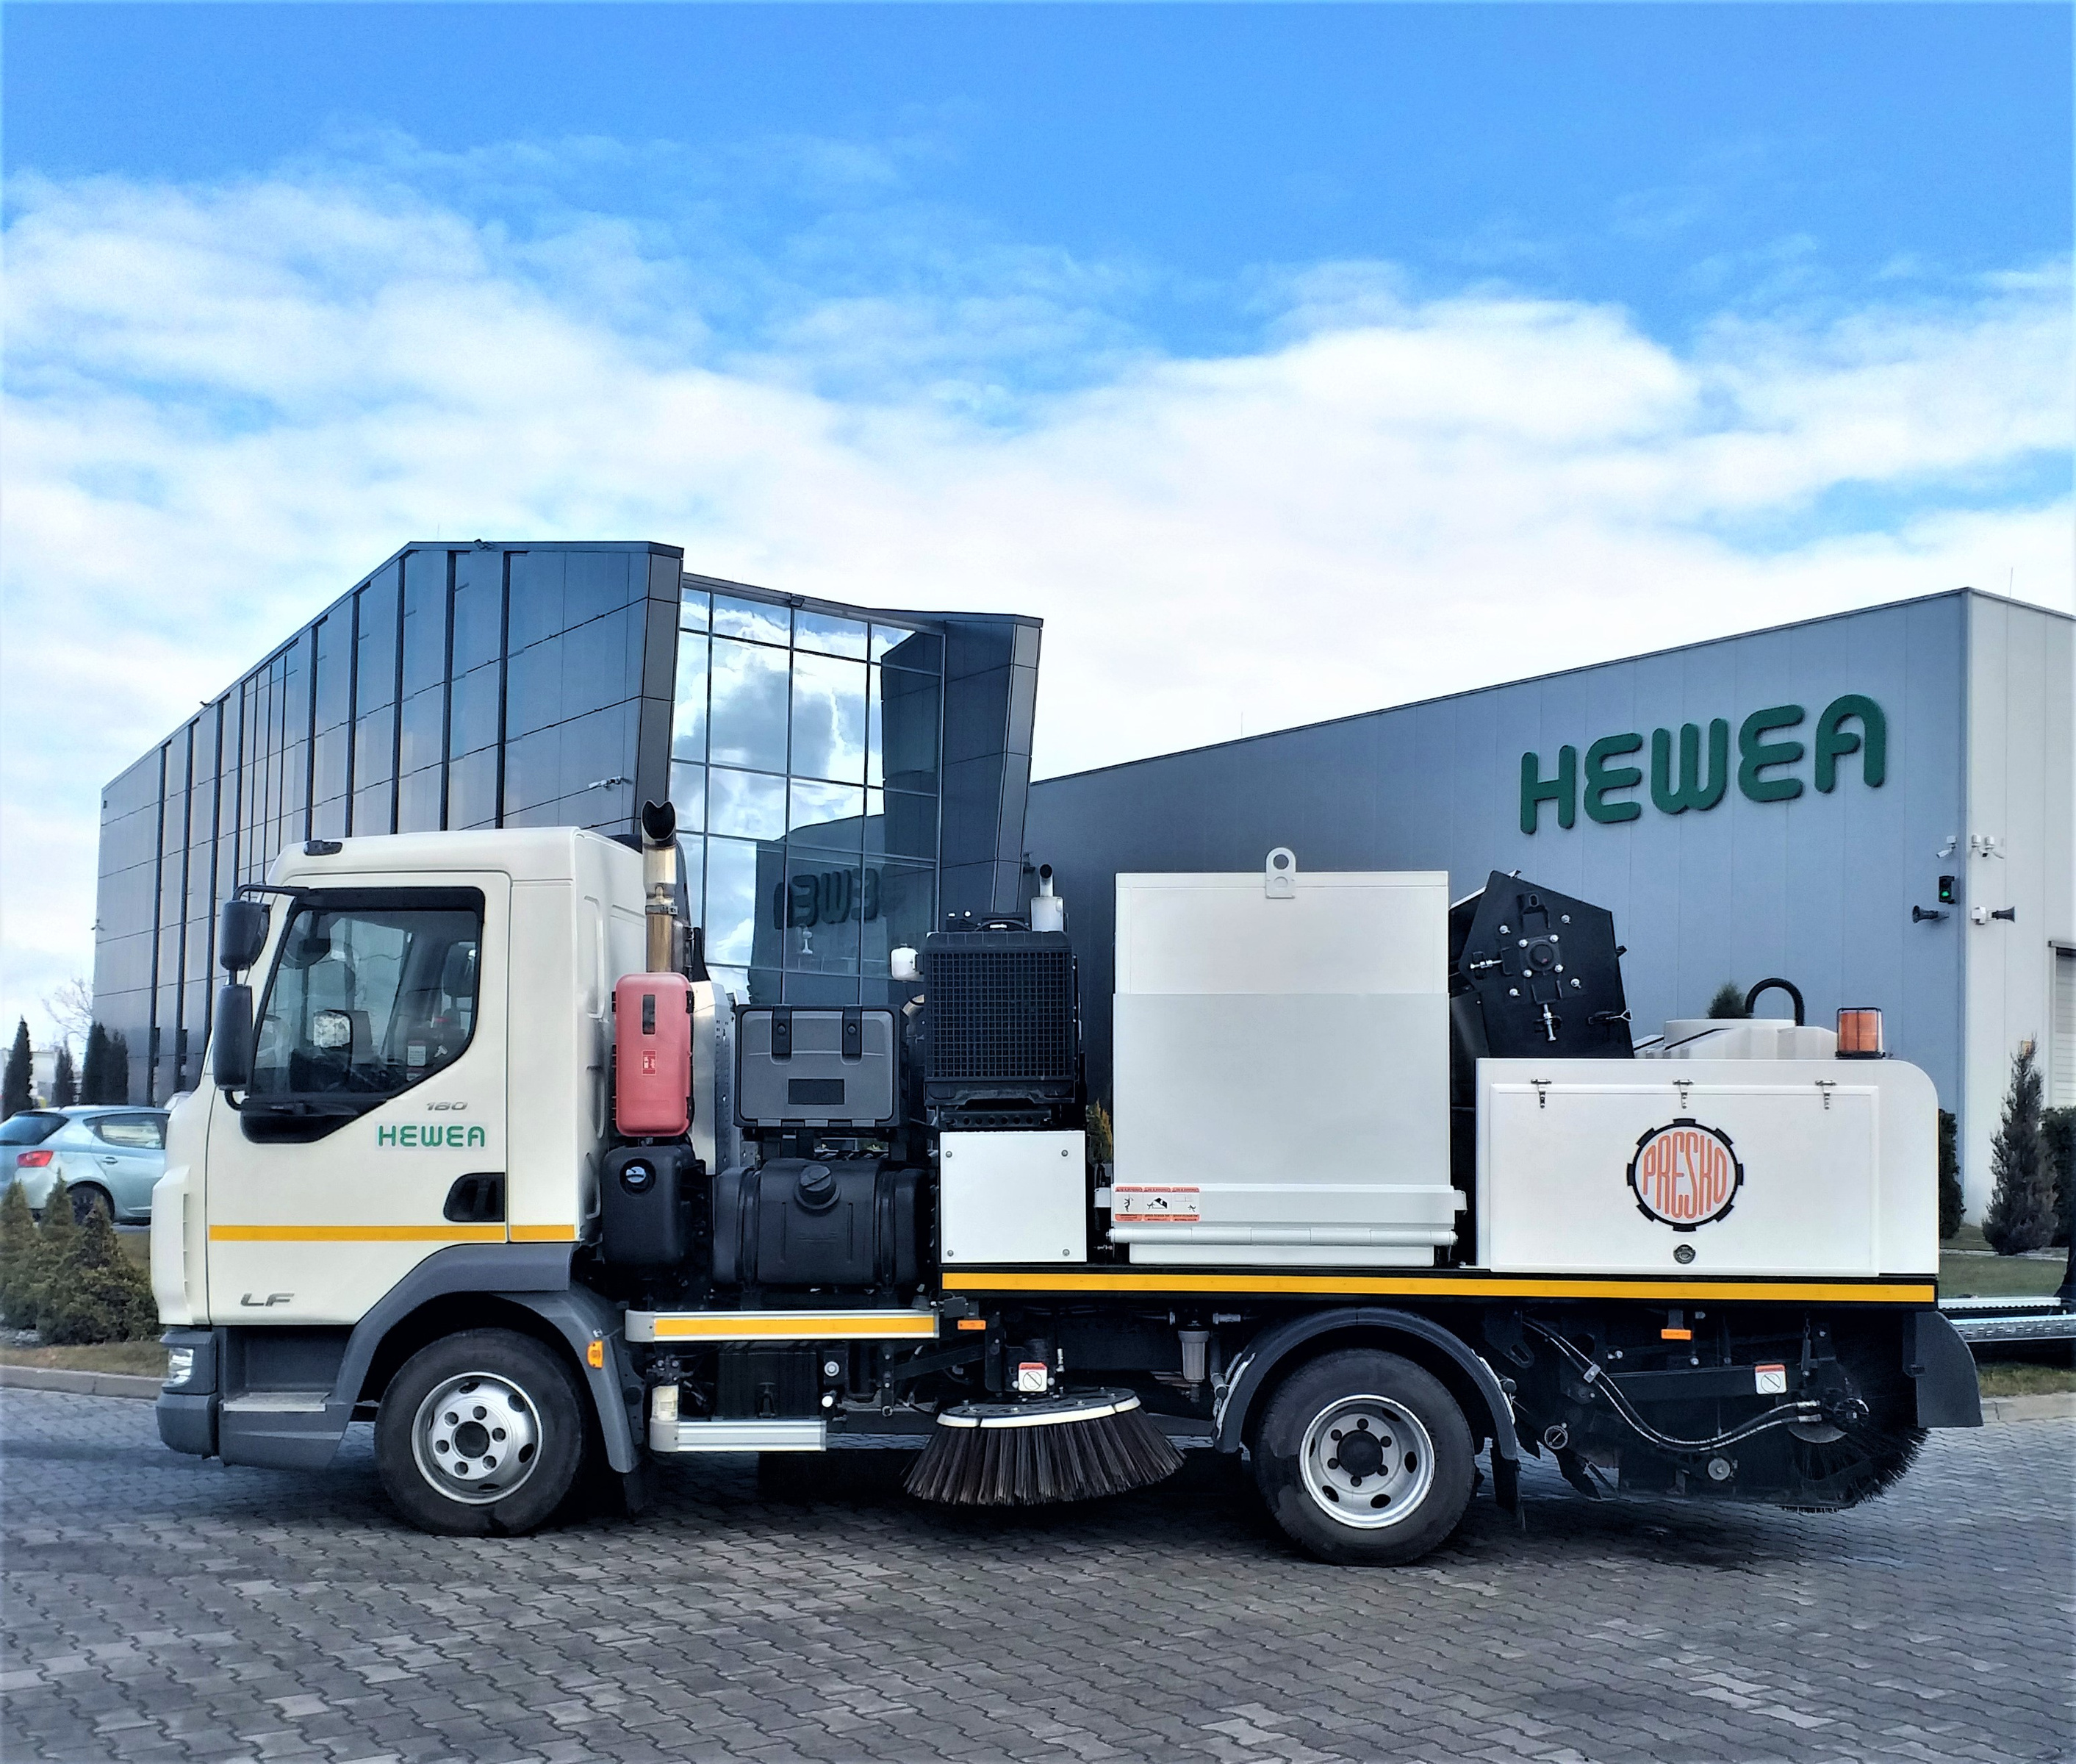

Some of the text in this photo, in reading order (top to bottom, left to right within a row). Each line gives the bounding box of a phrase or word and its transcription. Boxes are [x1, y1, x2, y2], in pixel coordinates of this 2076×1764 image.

[1520, 694, 1886, 835] HEWEA
[378, 1125, 485, 1147] HEWEA
[1642, 1131, 1728, 1219] PRESKO
[240, 1293, 295, 1307] LF
